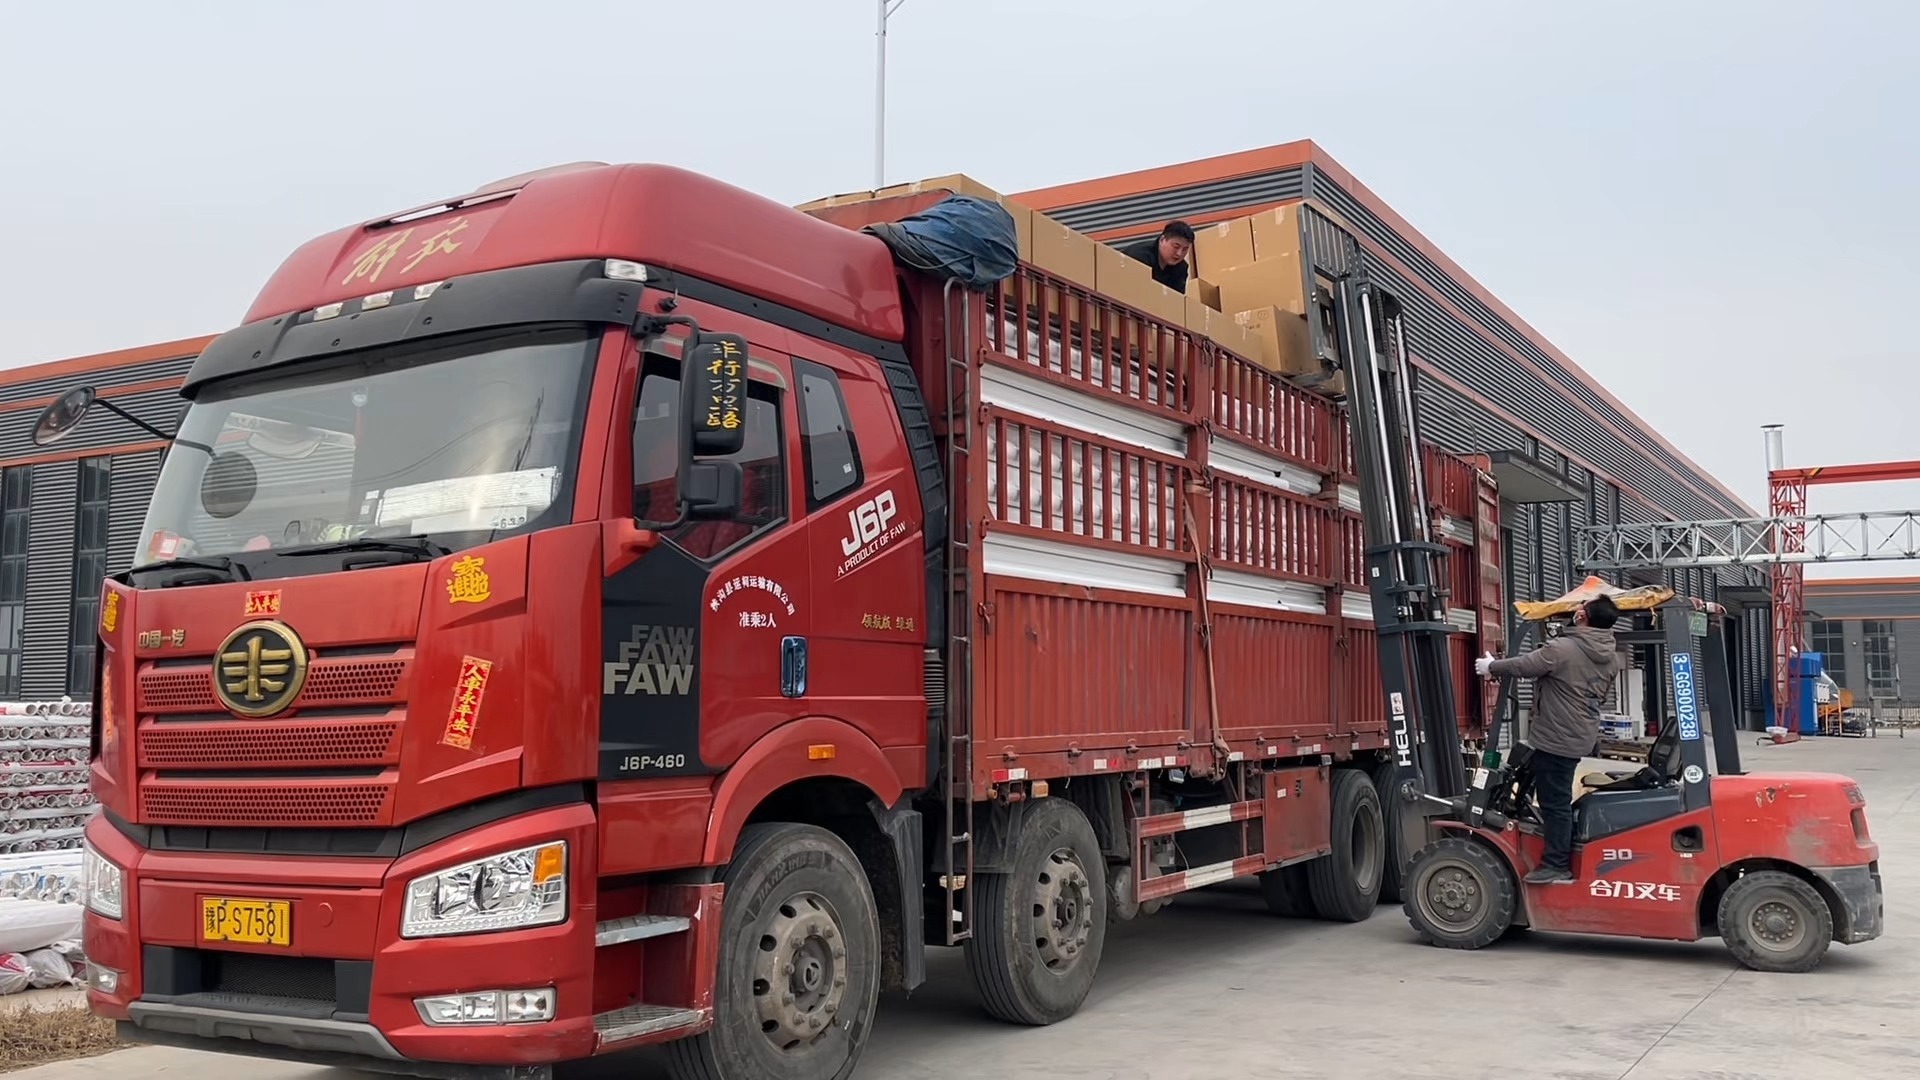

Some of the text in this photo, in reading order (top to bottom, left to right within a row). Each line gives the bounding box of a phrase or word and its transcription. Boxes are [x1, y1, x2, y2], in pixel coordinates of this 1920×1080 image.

[841, 489, 897, 557] J6P
[837, 520, 907, 577] A PRODUCT OF FAW
[738, 611, 777, 628] 准乘2人
[138, 629, 186, 649] 中国一汽
[632, 624, 695, 645] FAW
[619, 641, 695, 669] FAW
[603, 661, 694, 695] FAW
[1673, 655, 1697, 739] 3-GG900238
[1392, 714, 1412, 767] HELI
[619, 754, 685, 770] J6P-460
[1602, 848, 1633, 861] 30
[1589, 879, 1682, 902] 合力叉车
